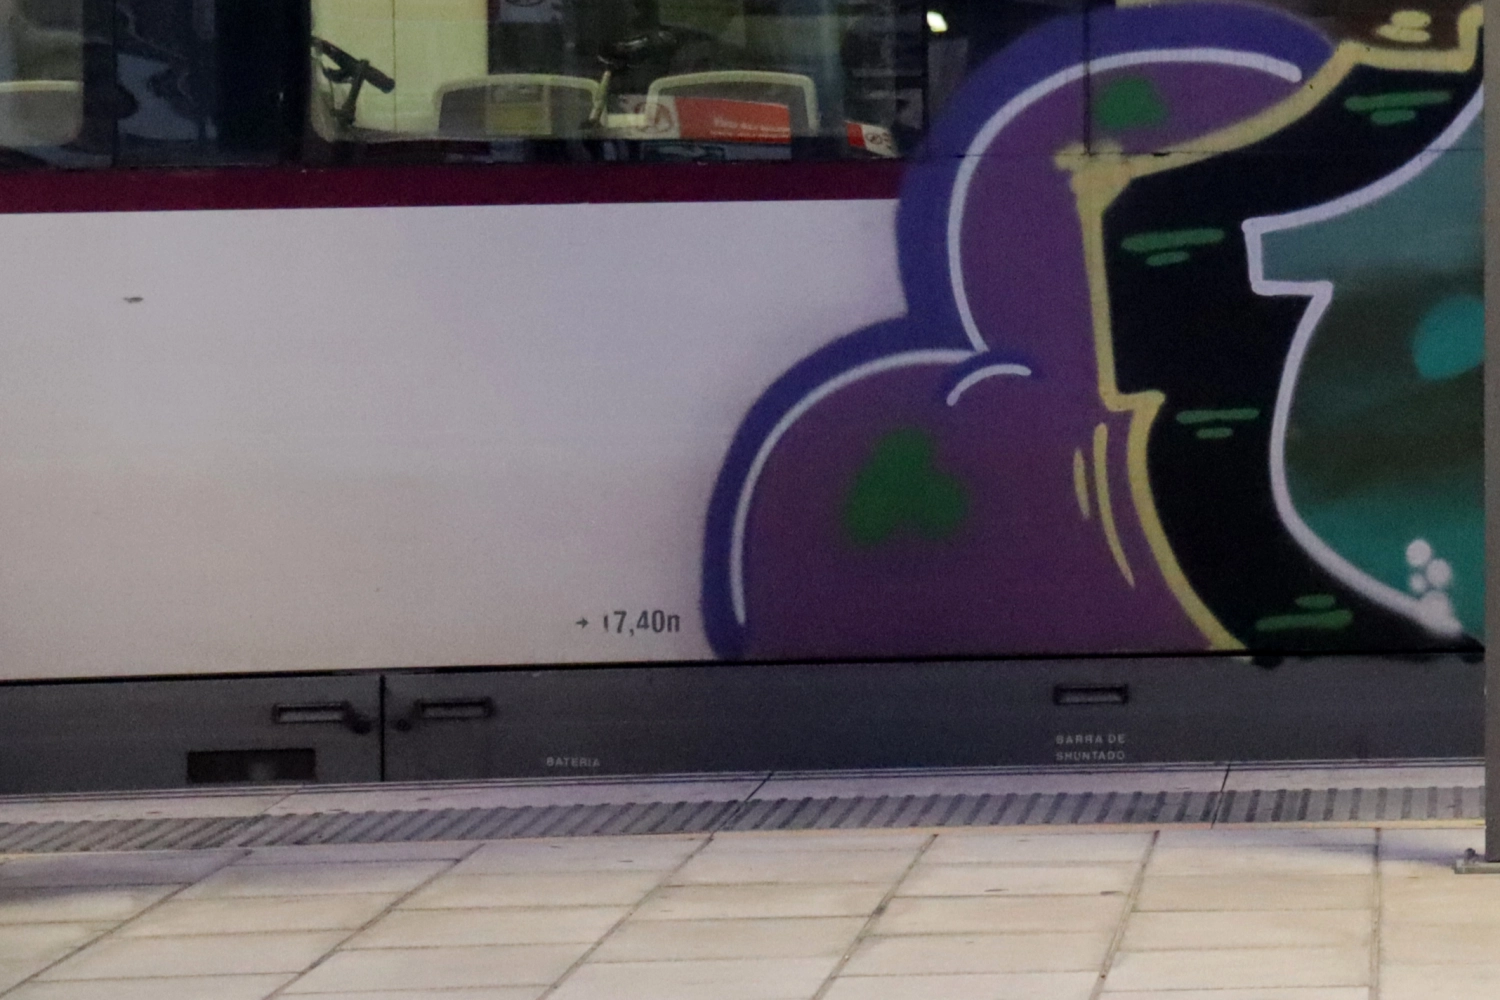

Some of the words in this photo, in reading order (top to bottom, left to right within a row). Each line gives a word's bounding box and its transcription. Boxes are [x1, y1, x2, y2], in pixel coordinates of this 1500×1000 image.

[1056, 734, 1103, 744] BARRA
[1108, 733, 1126, 744] DE
[1056, 750, 1125, 761] SHUNTADO
